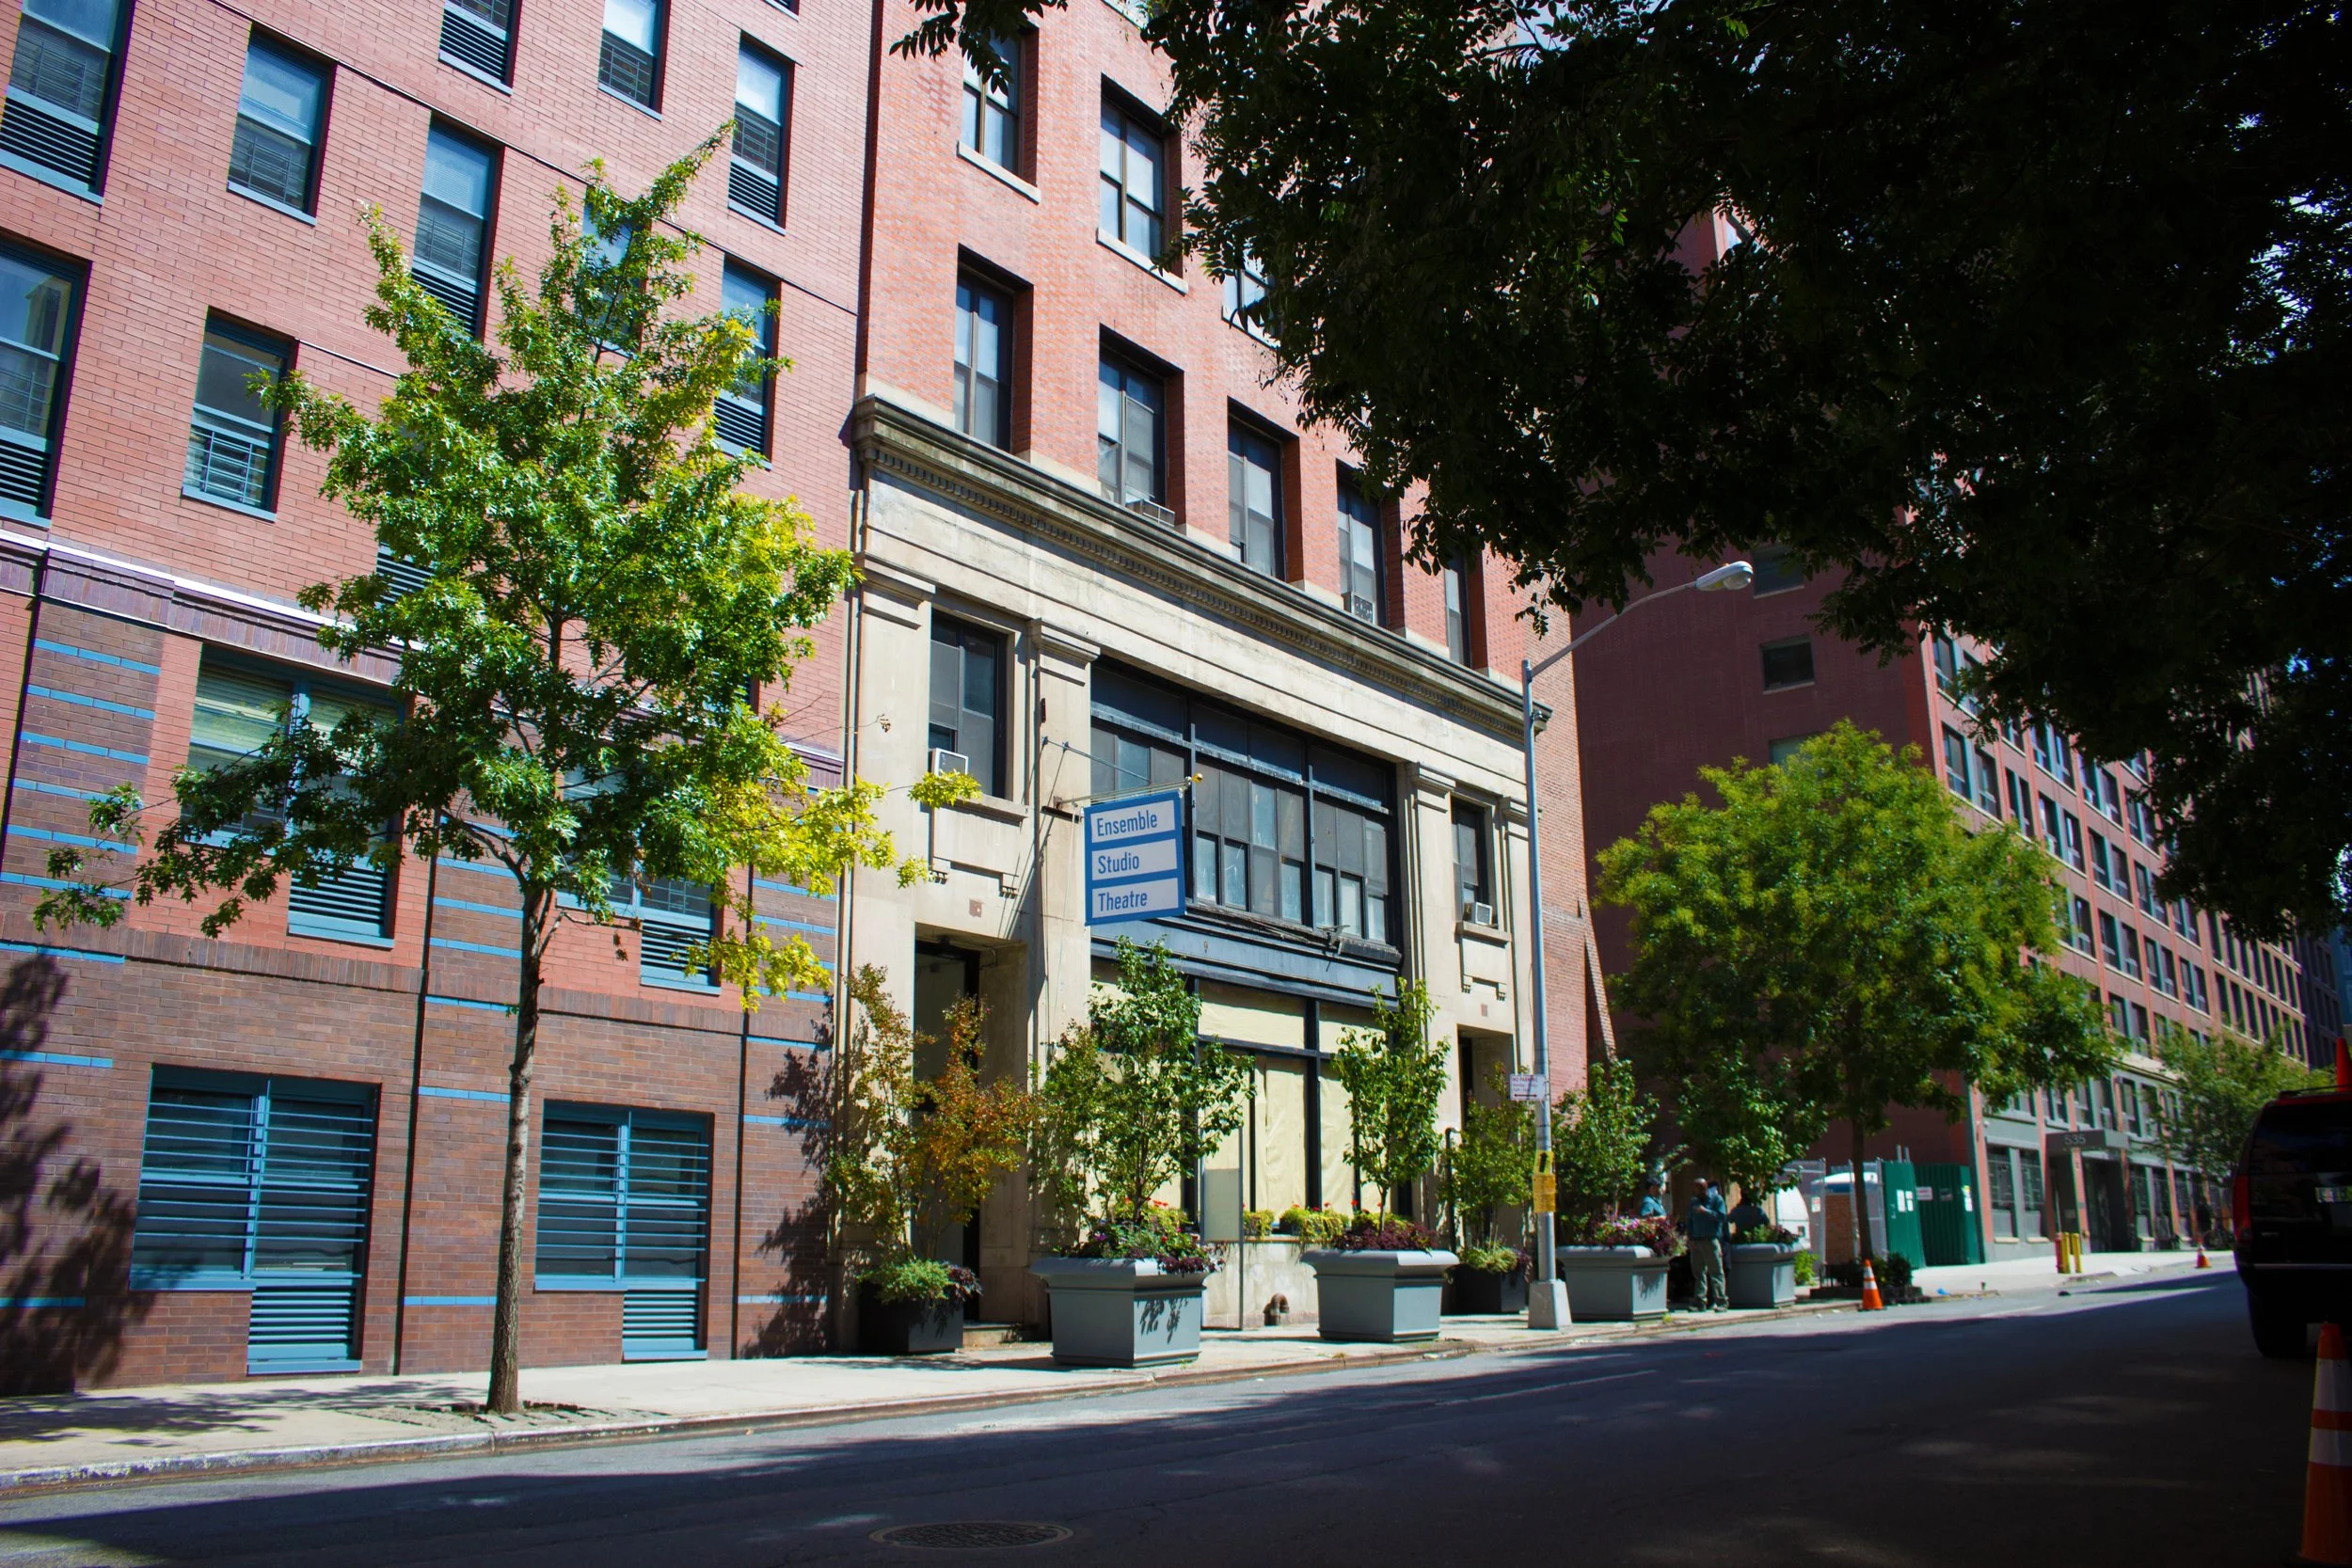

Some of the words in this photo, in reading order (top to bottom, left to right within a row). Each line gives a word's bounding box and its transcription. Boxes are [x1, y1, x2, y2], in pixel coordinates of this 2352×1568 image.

[1097, 810, 1157, 836] Ensemble
[1098, 851, 1139, 874] Studio
[1098, 891, 1148, 911] Theatre
[2064, 1133, 2087, 1145] 535
